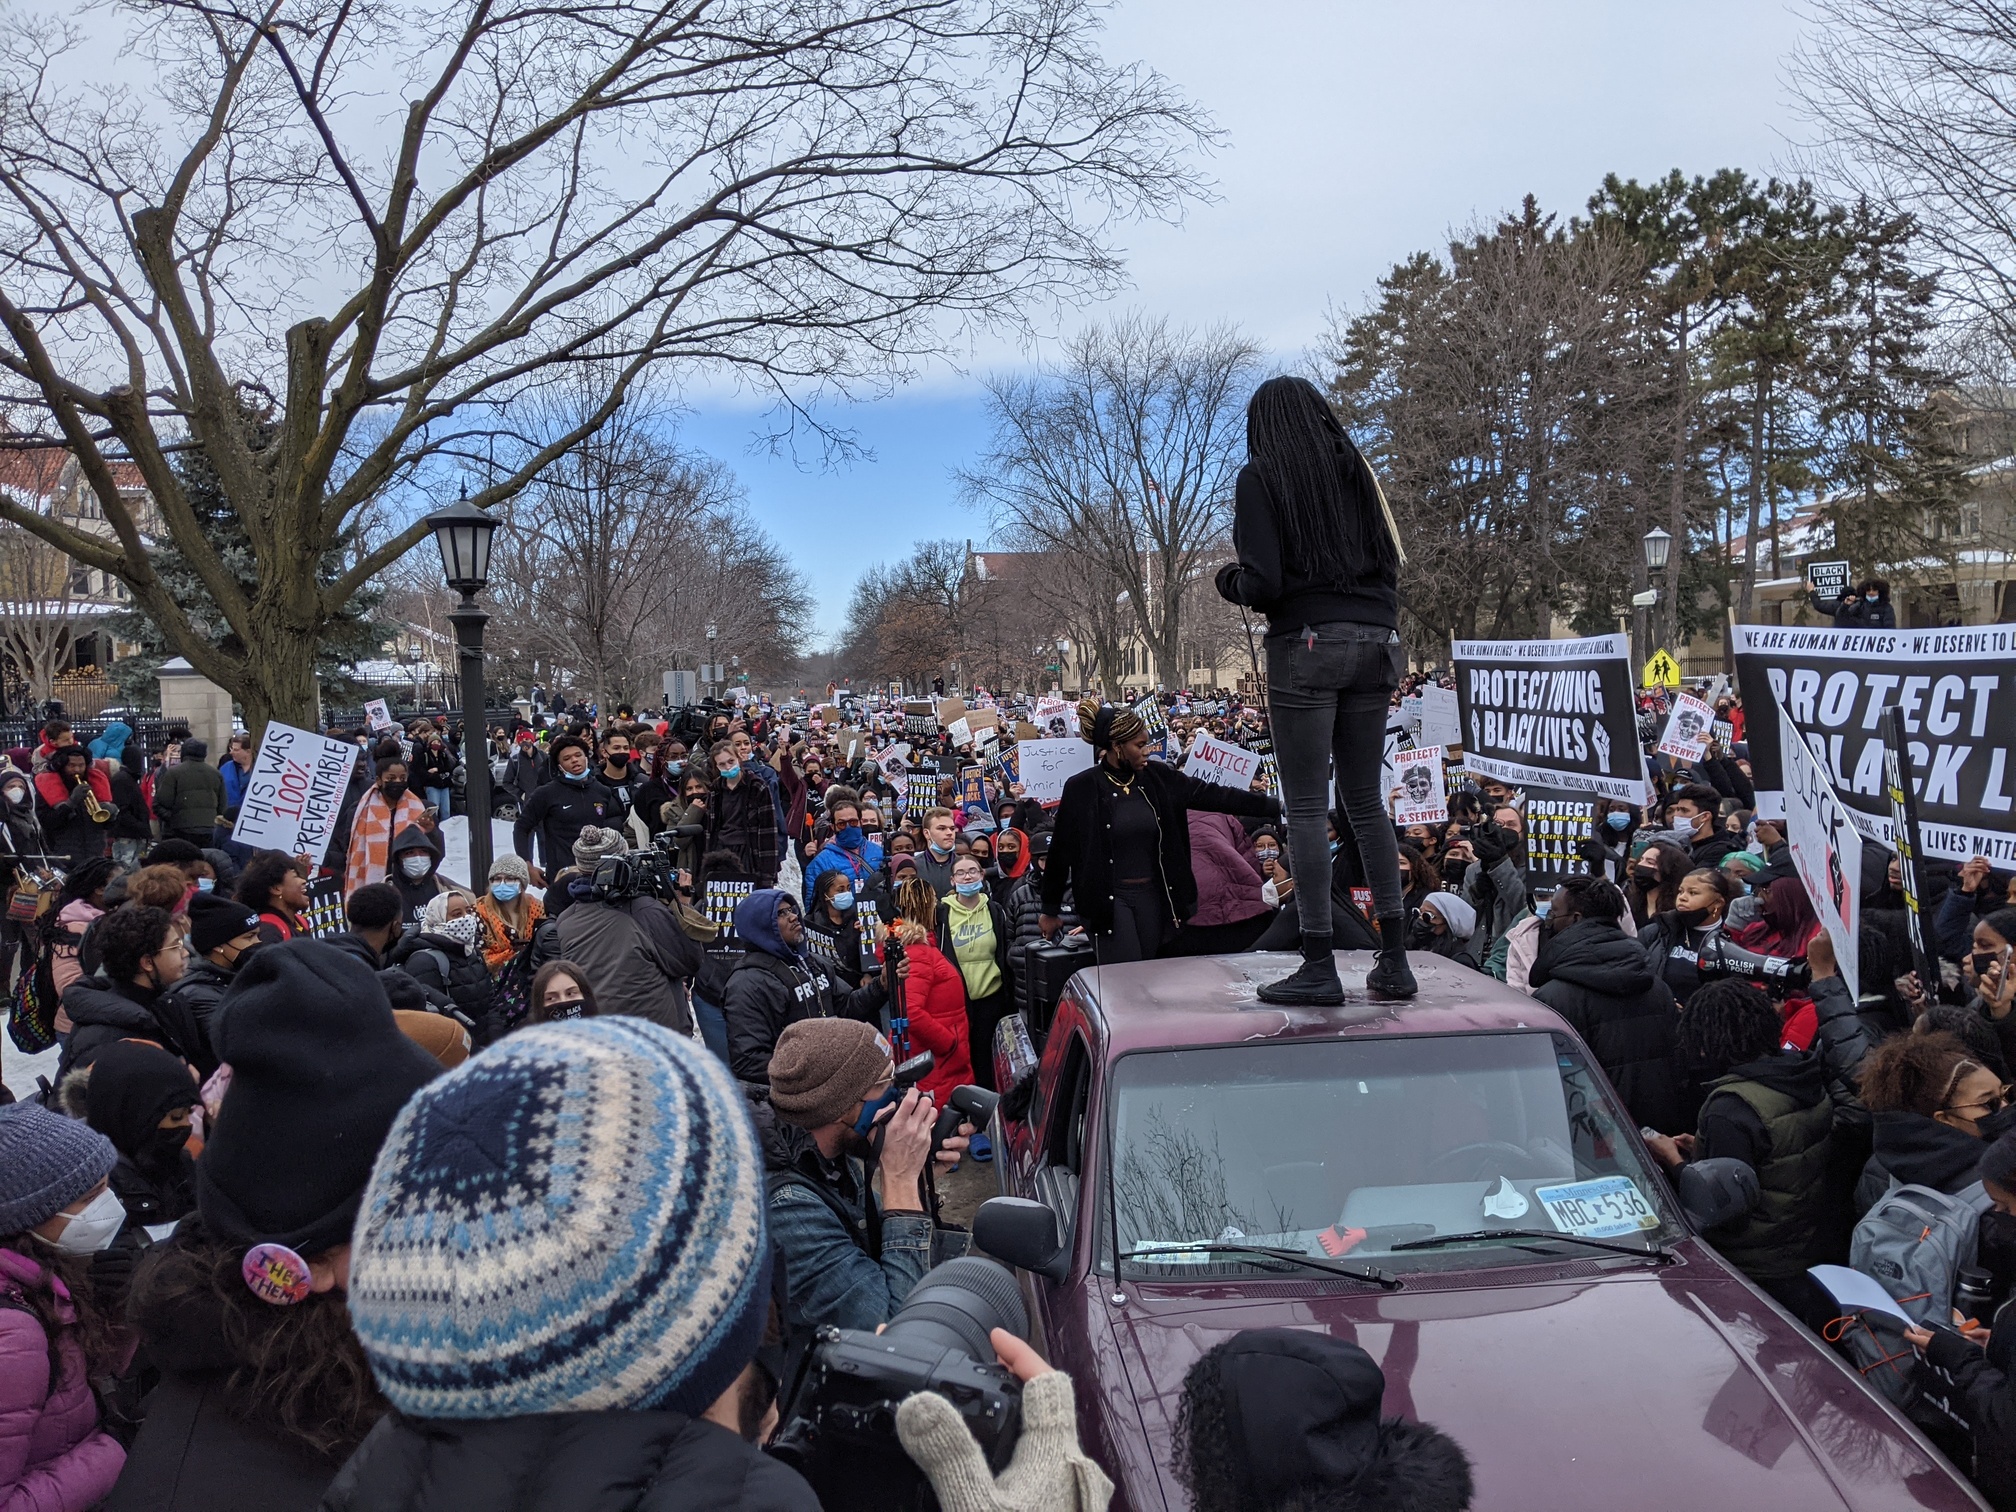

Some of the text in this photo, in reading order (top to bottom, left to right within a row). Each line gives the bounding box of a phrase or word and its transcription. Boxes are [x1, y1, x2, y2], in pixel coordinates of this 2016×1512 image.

[1815, 566, 1843, 575] BLACK
[1816, 577, 1842, 586] LIVES
[1466, 645, 1475, 656] ARE
[1476, 645, 1495, 656] HUMAN
[1495, 645, 1513, 656] BEINGS
[1518, 645, 1527, 657] WE
[1528, 644, 1549, 657] DESERVE
[1745, 631, 2006, 654] WE ARE HUMAN BEINGS WE DESERVE TO
[1244, 683, 1268, 693] LIVE
[1470, 668, 1605, 715] PROTECT YOUNG
[1244, 694, 1268, 706] MATT
[1680, 694, 1715, 716] PROTECT?
[1766, 667, 2000, 738] PROTECT
[1043, 703, 1068, 716] PROTECT?
[1484, 710, 1536, 754] BLACK
[1535, 715, 1588, 762] LIVES
[1023, 745, 1076, 757] Justice
[1194, 741, 1251, 777] JUSTICE
[1394, 747, 1440, 763] PROTECT?
[1660, 743, 1668, 751] &
[1669, 745, 1701, 761] SERVE?
[1041, 760, 1064, 772] for
[1214, 765, 1224, 776] FOR
[238, 729, 294, 837] THIS WAS
[908, 773, 937, 783] PROTECT
[1025, 778, 1054, 792] Amir
[1524, 768, 1538, 782] LIVES
[1538, 771, 1560, 786] MATTER
[1562, 775, 1585, 789] JUSTICE
[1585, 779, 1595, 791] FOR
[1595, 780, 1611, 794] AMIR
[1612, 783, 1632, 798] LOCKE
[272, 758, 311, 822] 100%
[909, 785, 937, 796] YOUNG
[1787, 721, 1845, 864] BLACK
[293, 740, 349, 859] PREVENTABLE
[323, 763, 351, 836] TOTAL ABOLITION
[908, 796, 937, 807] BLACK
[908, 808, 923, 817] LIV
[1398, 809, 1446, 823] & SERVE?
[1528, 800, 1594, 817] PROTECT
[1527, 819, 1592, 837] YOUNG
[1528, 838, 1576, 855] BLAC
[1927, 829, 1967, 853] LIVES
[1972, 835, 2016, 861] MATTE
[1529, 857, 1589, 875] LIVES
[706, 881, 755, 894] PROTECT
[706, 896, 744, 907] YOUN
[960, 922, 984, 936] NIKE
[1730, 965, 1754, 975] POLICE
[794, 972, 830, 1002] PRSS
[1563, 1183, 1610, 1197] Minnesota
[1550, 1189, 1647, 1228] MBC 536
[1614, 1222, 1632, 1231] lakes
[249, 1269, 295, 1305] THEM
